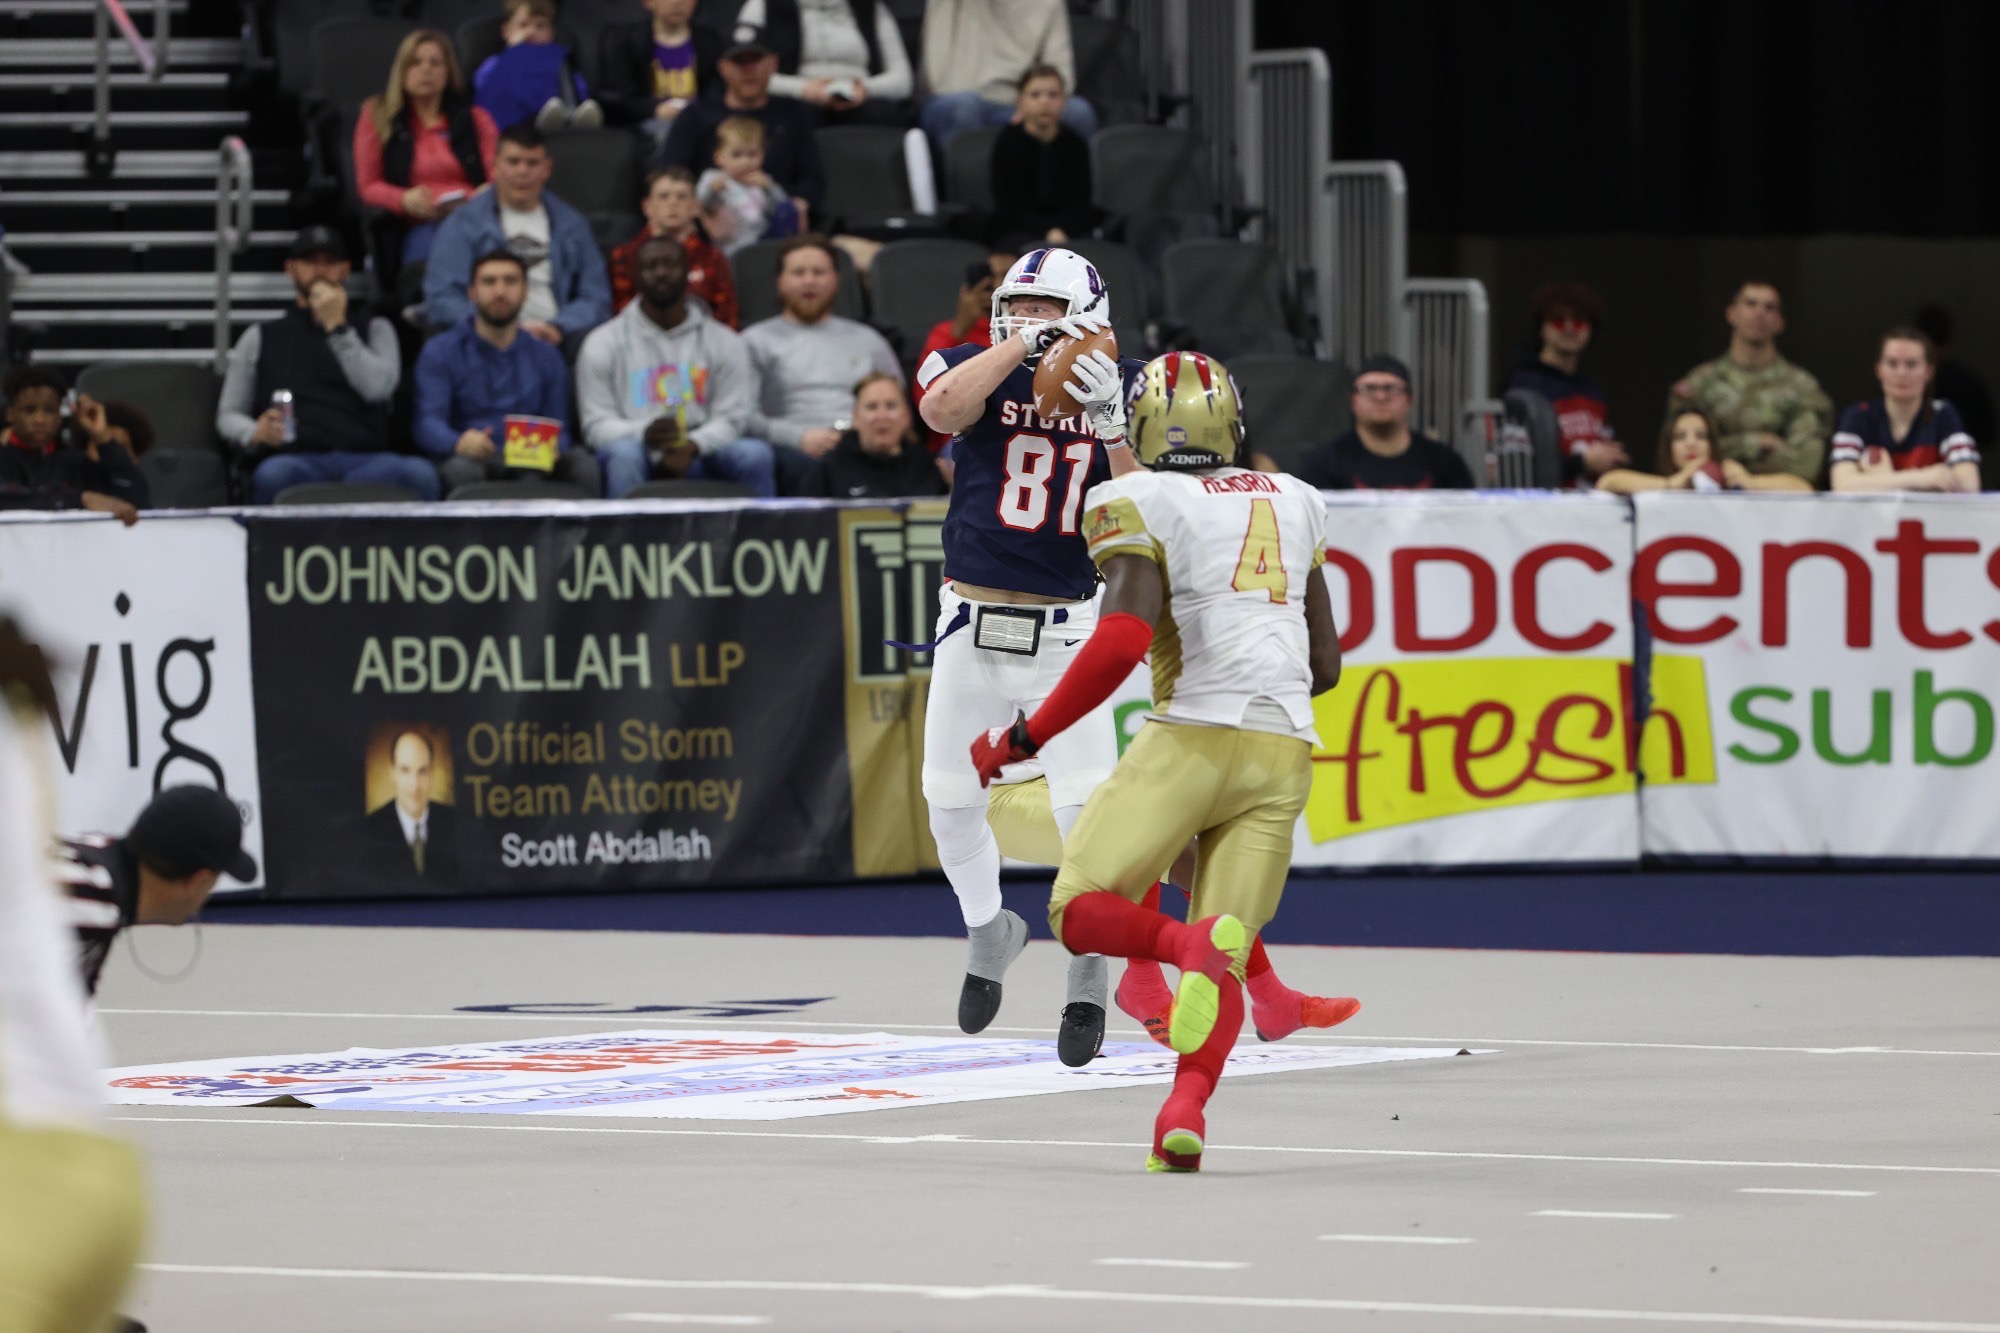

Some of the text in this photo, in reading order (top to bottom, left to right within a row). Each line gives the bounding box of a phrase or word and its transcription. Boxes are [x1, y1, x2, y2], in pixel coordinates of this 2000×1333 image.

[997, 431, 1094, 536] 81
[1168, 453, 1213, 466] XENITH
[1200, 473, 1282, 495] HENDRIX
[266, 538, 828, 604] JOHNSON JANKLOW
[1231, 498, 1288, 604] 4
[353, 633, 745, 693] ABDALLAH LLP
[467, 719, 733, 768] Official Storm
[1312, 662, 1685, 823] fresh
[464, 771, 743, 820] Team Attorney
[501, 829, 711, 867] Scott Abdallah
